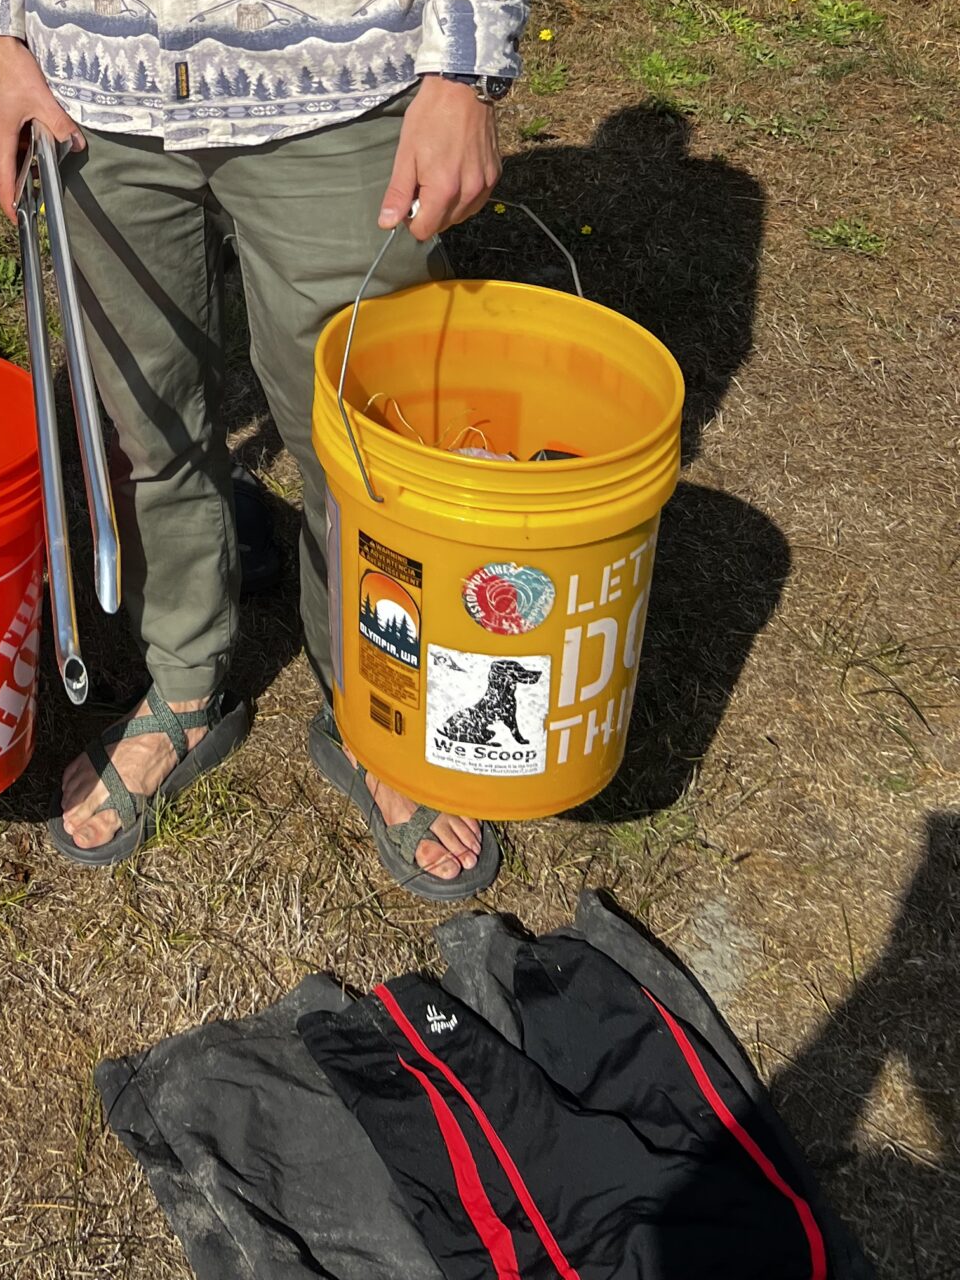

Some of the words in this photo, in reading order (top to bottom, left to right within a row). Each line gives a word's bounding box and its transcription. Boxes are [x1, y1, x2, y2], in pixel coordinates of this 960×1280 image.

[566, 534, 656, 616] LET
[401, 650, 418, 666] WA
[434, 737, 466, 756] We
[473, 747, 538, 763] Scoop
[549, 685, 632, 765] THI
